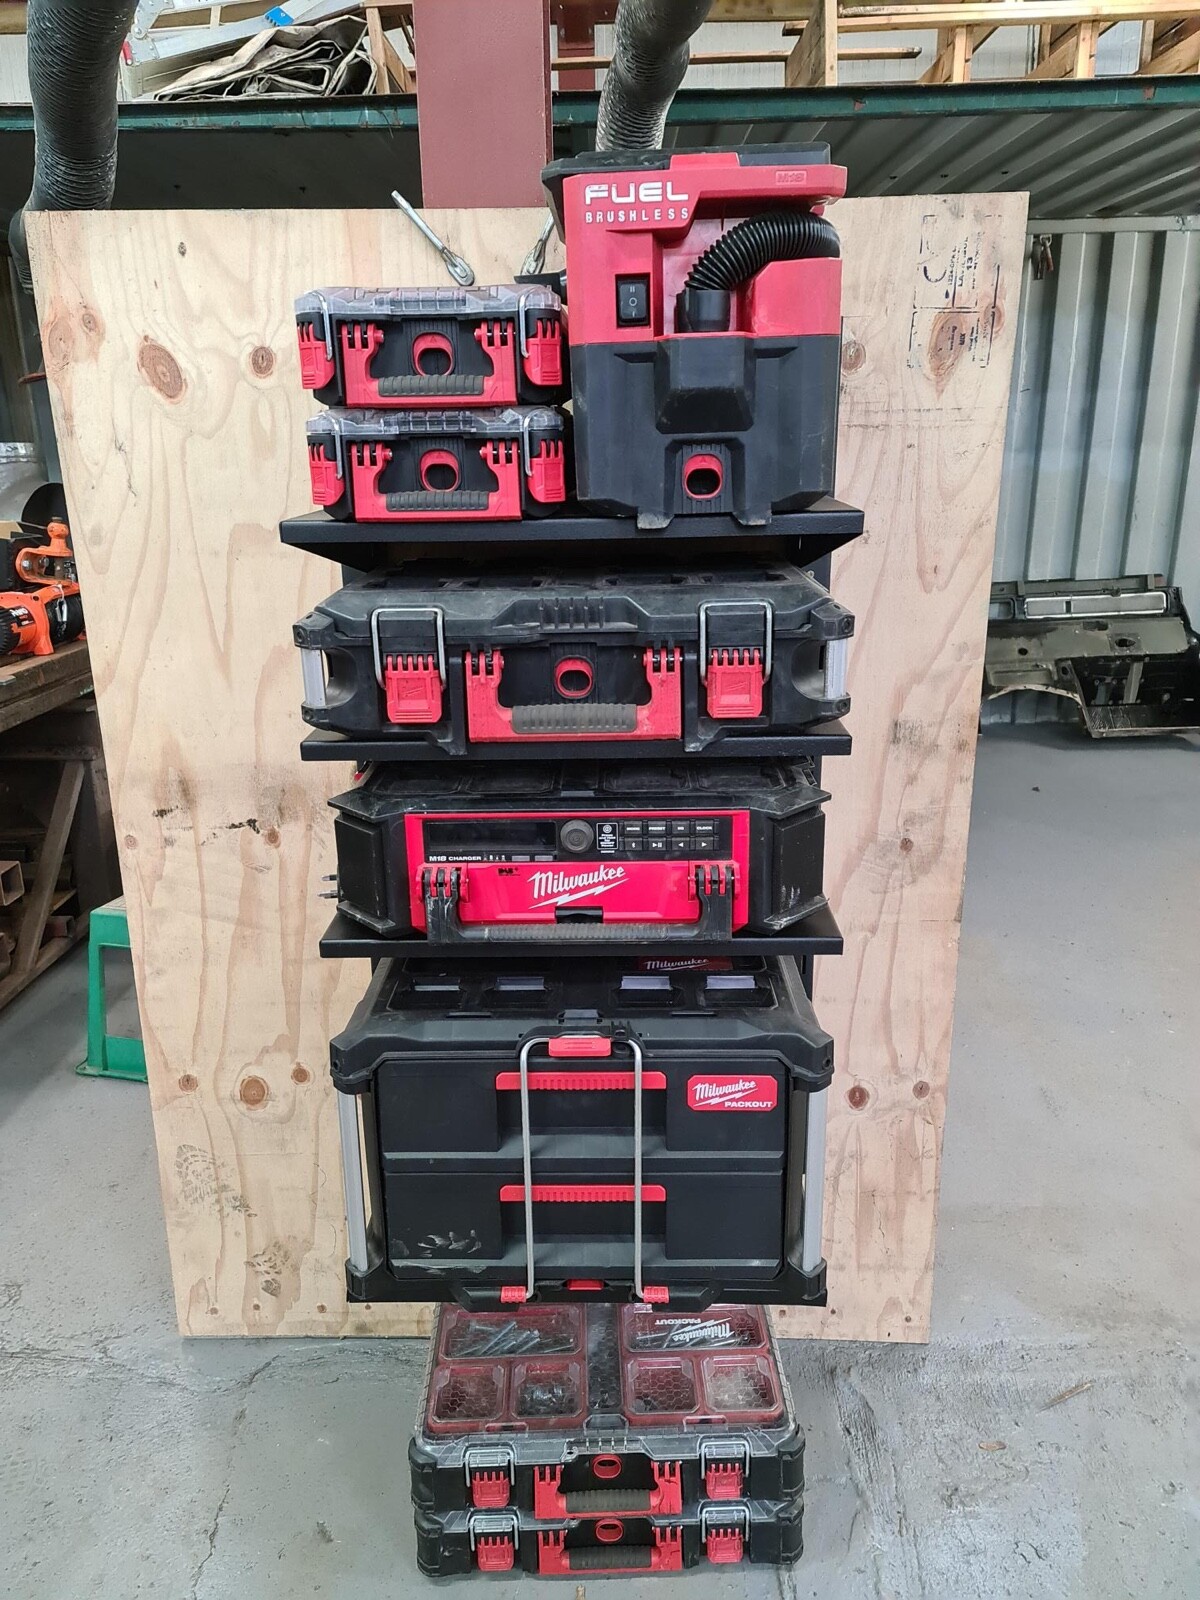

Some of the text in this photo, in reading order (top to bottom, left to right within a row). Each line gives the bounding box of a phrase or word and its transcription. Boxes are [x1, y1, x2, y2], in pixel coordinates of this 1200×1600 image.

[585, 181, 689, 205] FUEL
[585, 207, 689, 224] BRUSHLESS
[528, 864, 626, 899] Milwaukee
[643, 958, 709, 970] Milwaukee
[692, 1079, 757, 1101] Milwaukee
[672, 1322, 735, 1342] Milwaukee
